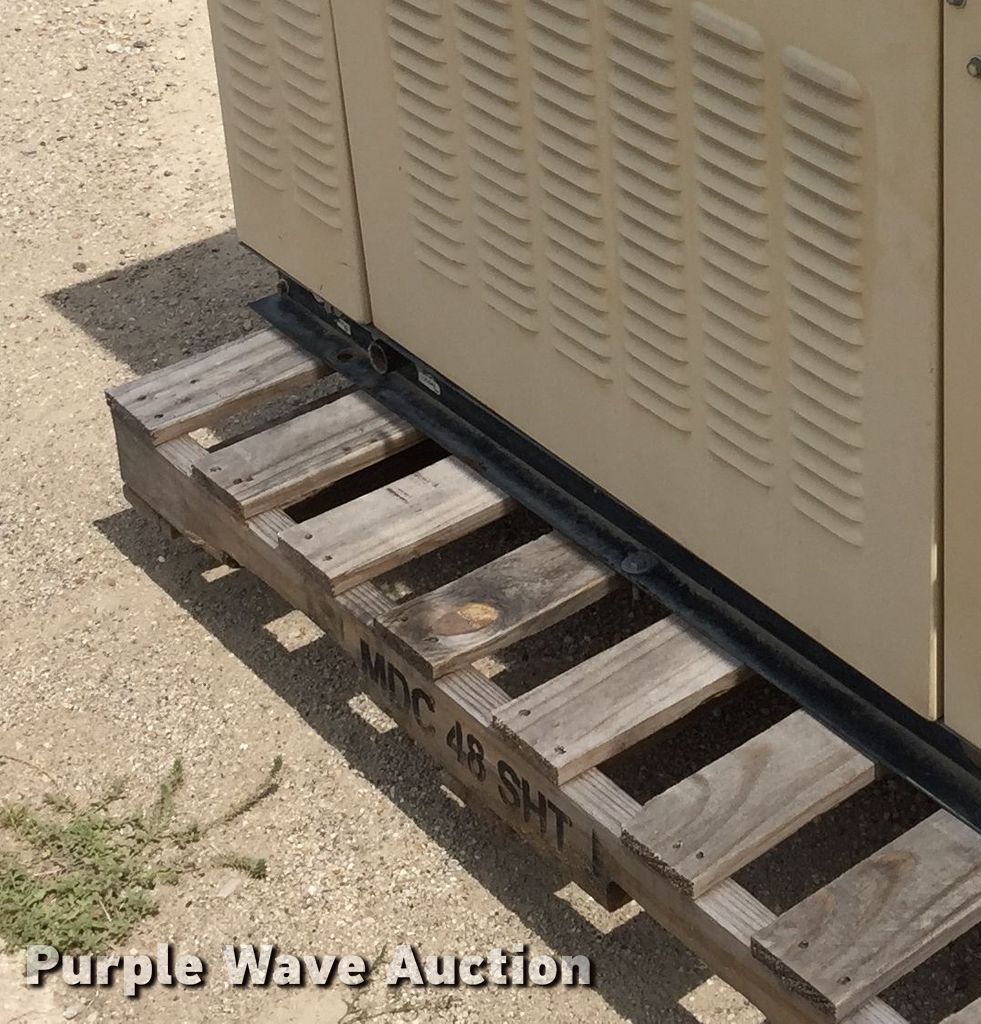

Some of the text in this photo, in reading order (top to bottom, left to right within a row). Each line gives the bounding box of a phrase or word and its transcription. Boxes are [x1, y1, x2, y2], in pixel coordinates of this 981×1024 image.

[359, 637, 573, 851] MDC 48 SHT
